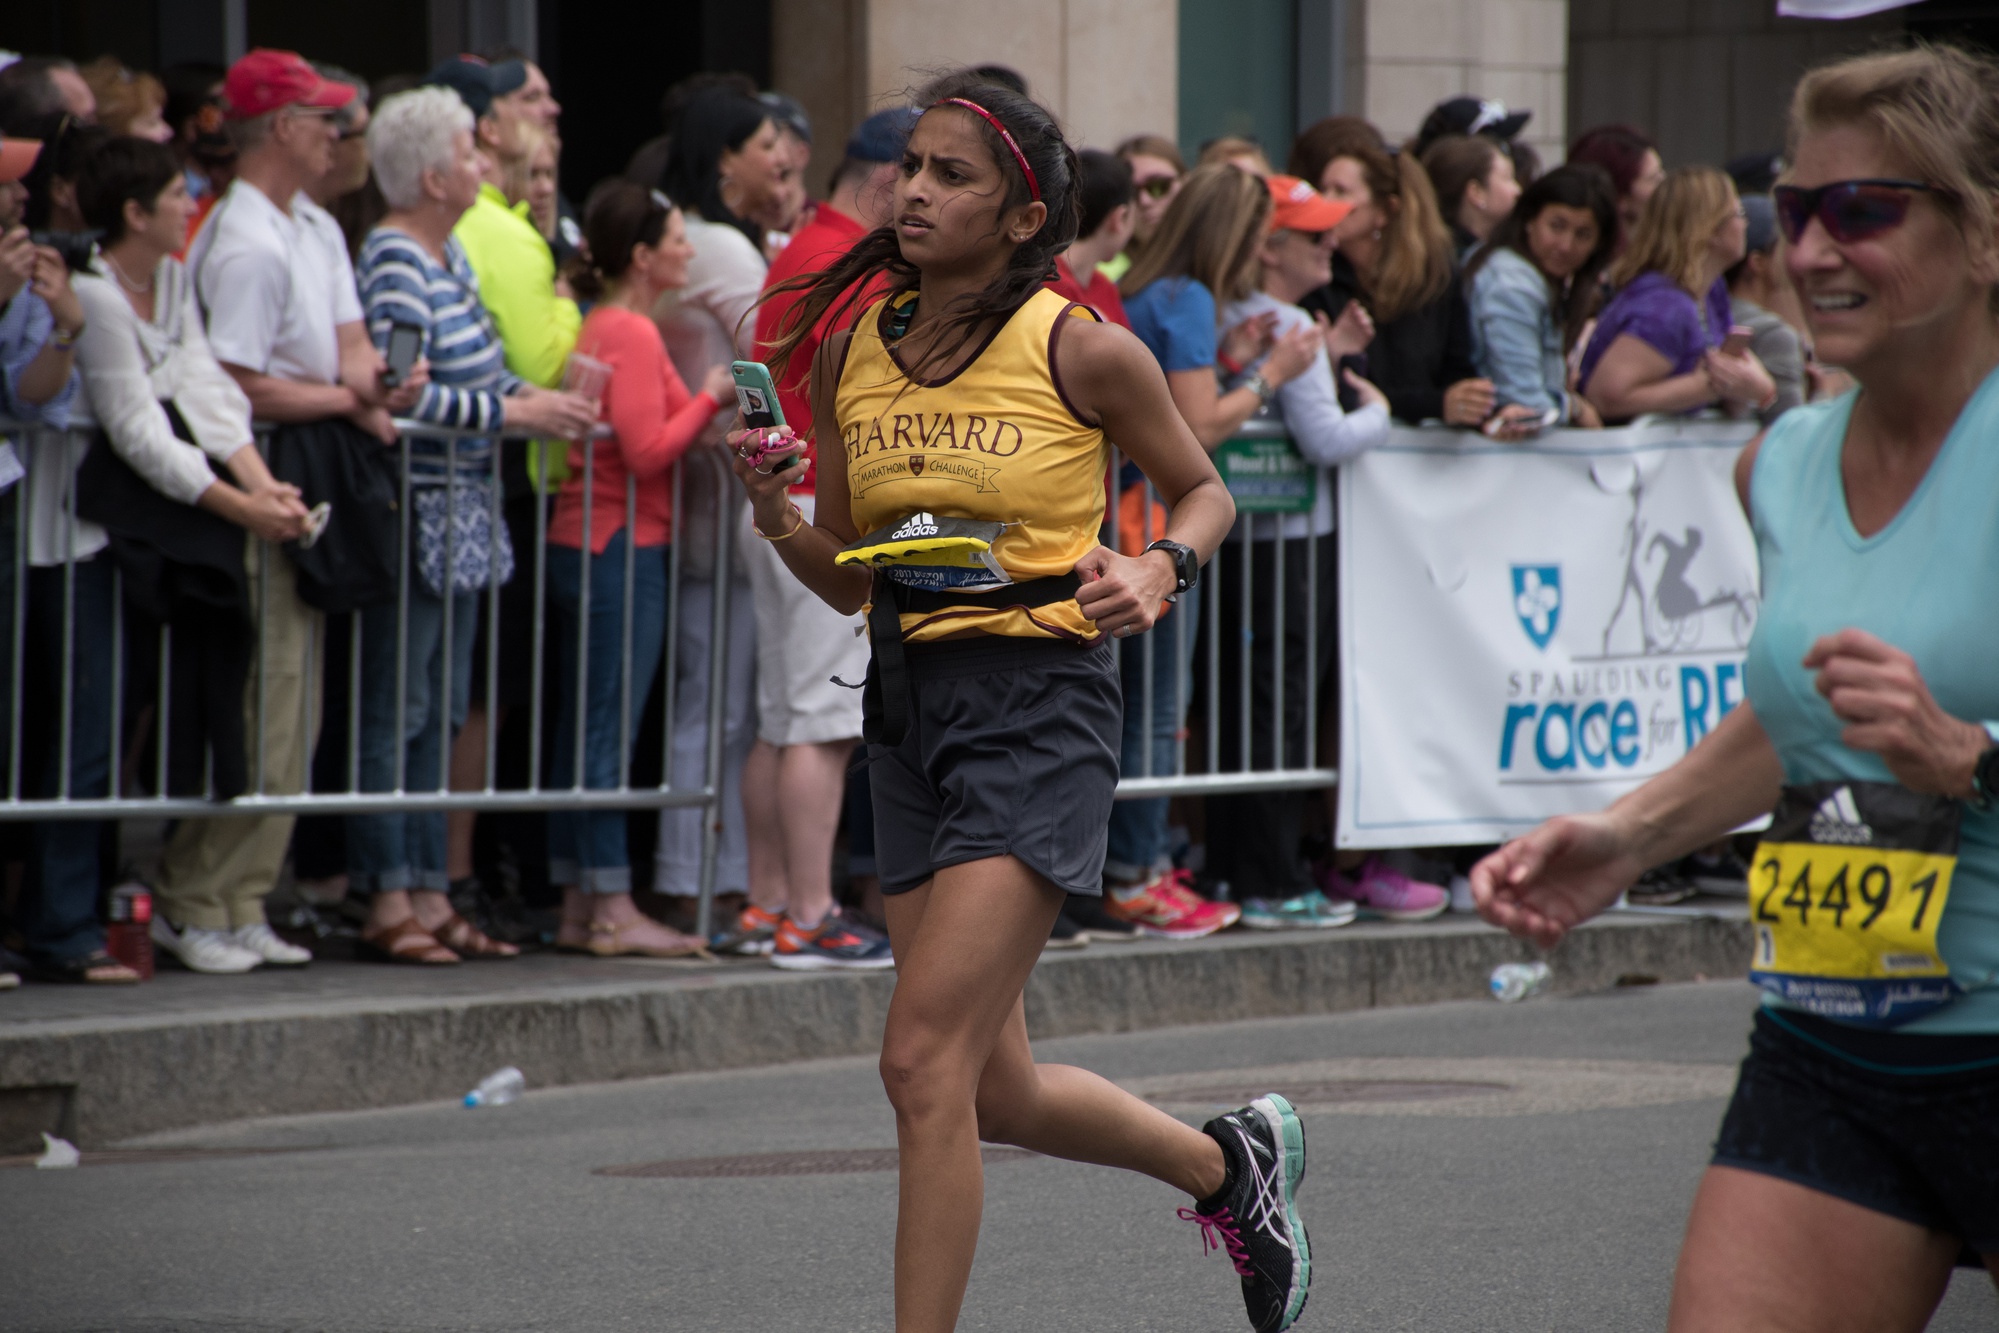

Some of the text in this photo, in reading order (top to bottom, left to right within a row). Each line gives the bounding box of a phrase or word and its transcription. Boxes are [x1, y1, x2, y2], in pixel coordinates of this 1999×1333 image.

[847, 412, 1023, 465] HARVARD
[860, 459, 979, 485] MARATHON CHALLENGE
[891, 523, 939, 540] adidas
[893, 569, 912, 579] 2017
[1507, 664, 1672, 698] SPAULDING
[1499, 664, 1747, 771] race for RE
[1757, 858, 1938, 931] 24491
